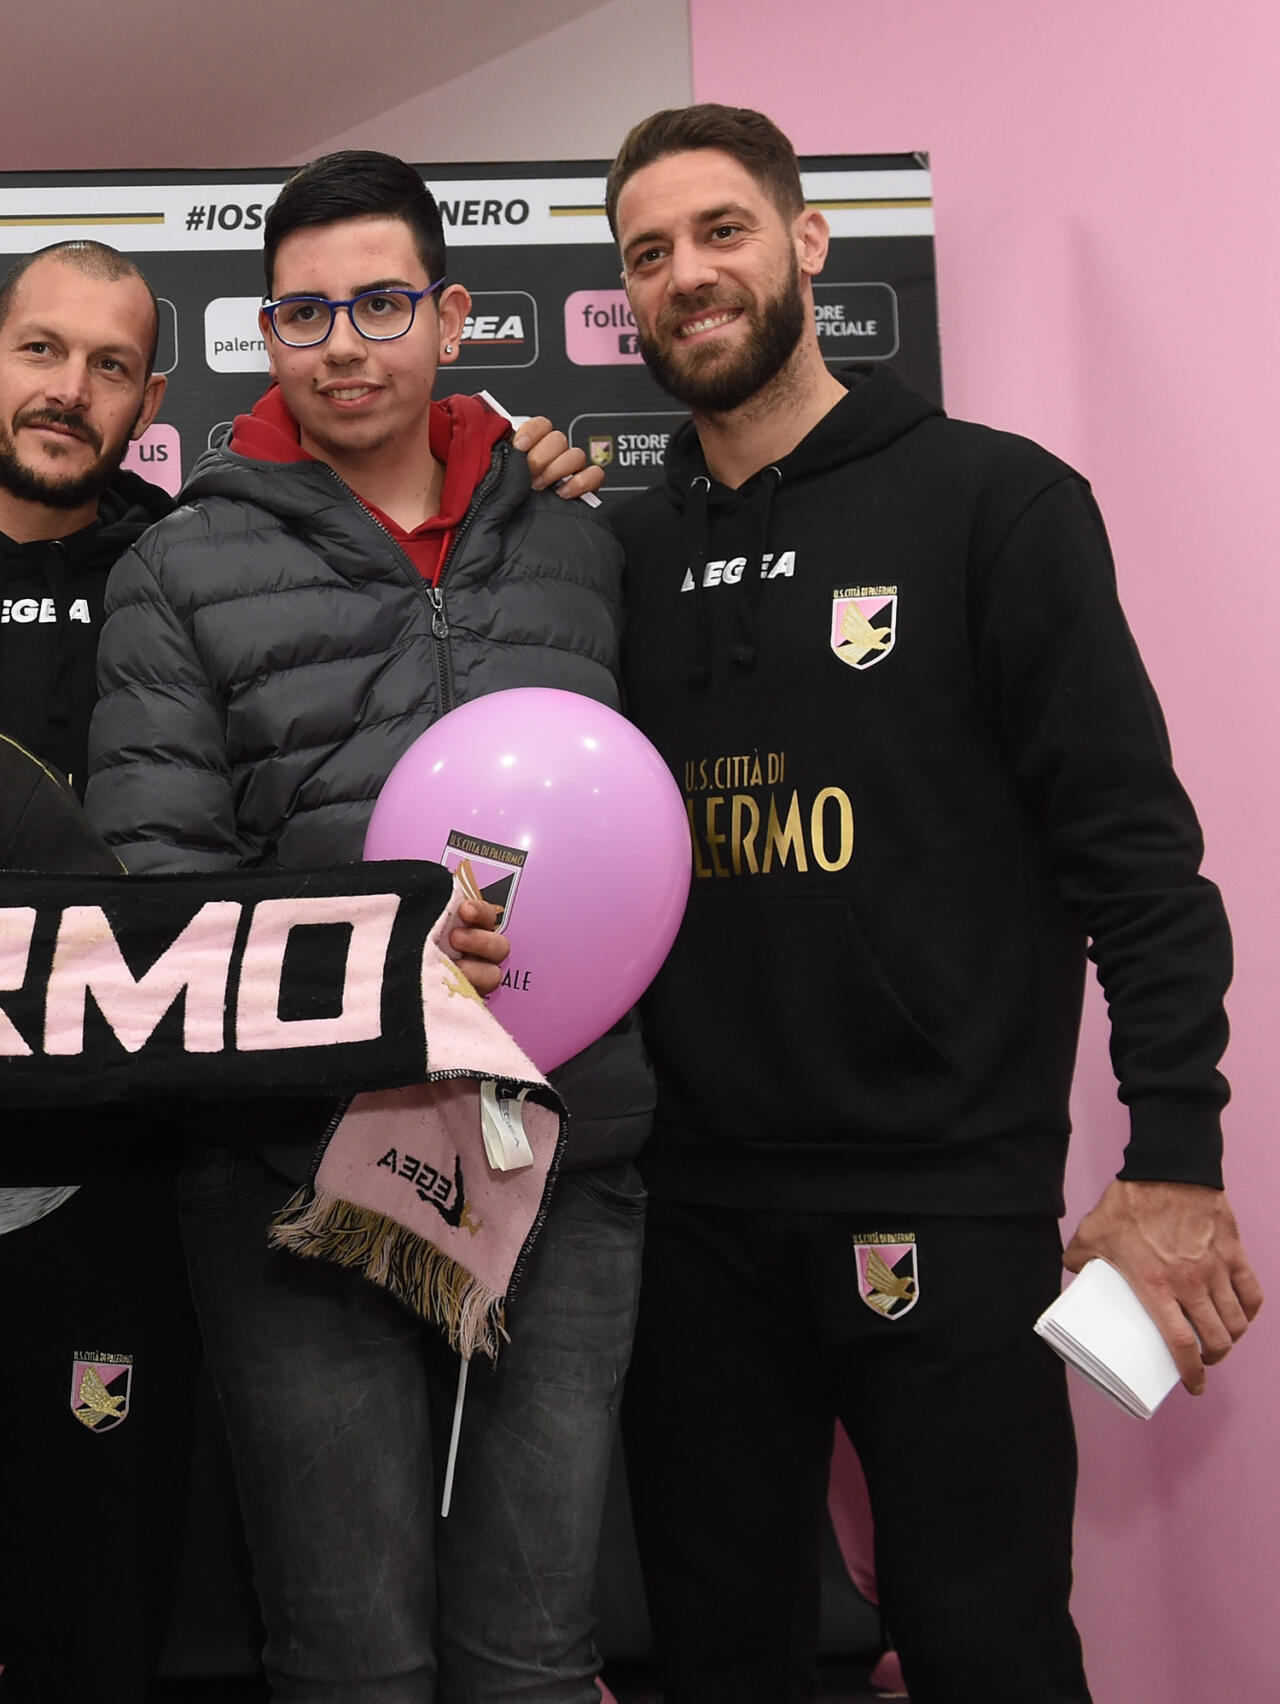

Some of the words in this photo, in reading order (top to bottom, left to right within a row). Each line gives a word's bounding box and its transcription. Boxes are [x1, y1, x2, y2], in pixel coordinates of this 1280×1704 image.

[814, 305, 845, 320] ORE
[461, 315, 524, 339] GEA
[815, 320, 877, 336] FICIALE
[617, 434, 670, 450] STORE
[139, 444, 168, 462] us
[618, 450, 665, 466] UFFIC
[768, 752, 785, 784] DI
[686, 786, 854, 878] LERMO
[499, 967, 533, 991] ALE
